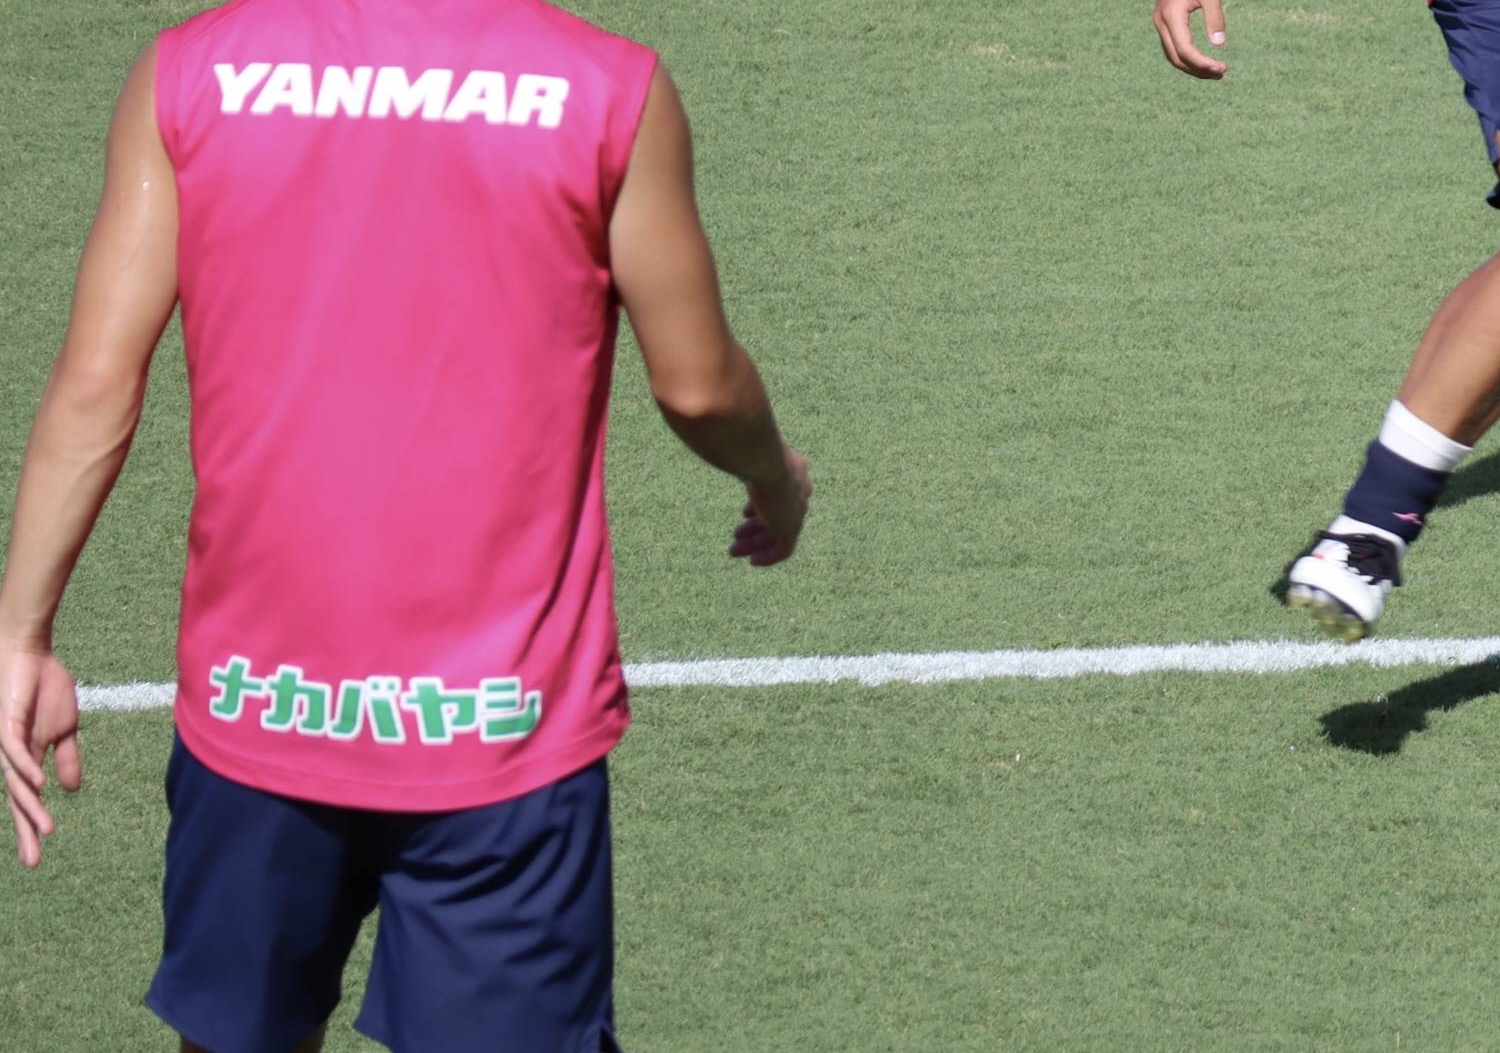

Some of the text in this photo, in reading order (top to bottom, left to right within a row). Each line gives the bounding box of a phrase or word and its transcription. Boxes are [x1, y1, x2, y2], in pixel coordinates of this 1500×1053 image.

[213, 62, 570, 129] YANMAR
[208, 655, 542, 745] ナカバヤシ
